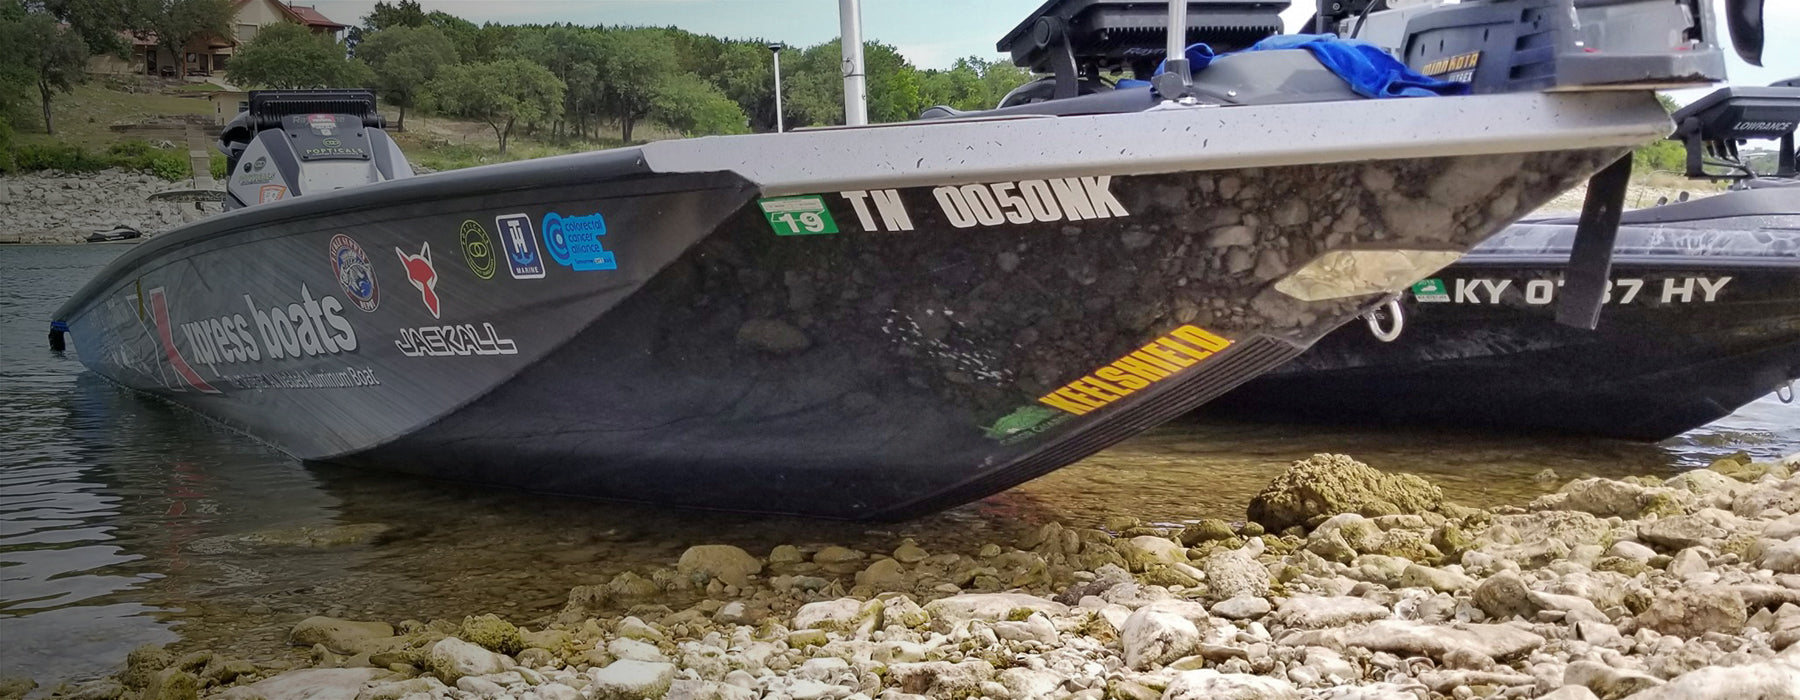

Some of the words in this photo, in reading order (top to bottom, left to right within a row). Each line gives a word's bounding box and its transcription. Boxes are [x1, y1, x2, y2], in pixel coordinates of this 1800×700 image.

[1448, 52, 1479, 71] KOTA
[1733, 121, 1792, 131] LOWRANCE
[840, 189, 914, 232] TN
[932, 175, 1130, 229] 0050NK
[564, 219, 602, 232] colorectal
[778, 212, 824, 233] 19
[569, 233, 593, 243] cancer
[572, 242, 600, 254] alliance
[516, 266, 539, 274] MARINE
[1454, 278, 1512, 304] KY
[1526, 278, 1644, 305] 07
[1661, 276, 1732, 303] HY
[243, 281, 357, 359] boats
[347, 366, 381, 386] Boat
[1038, 324, 1231, 415] KEELSHIELD
